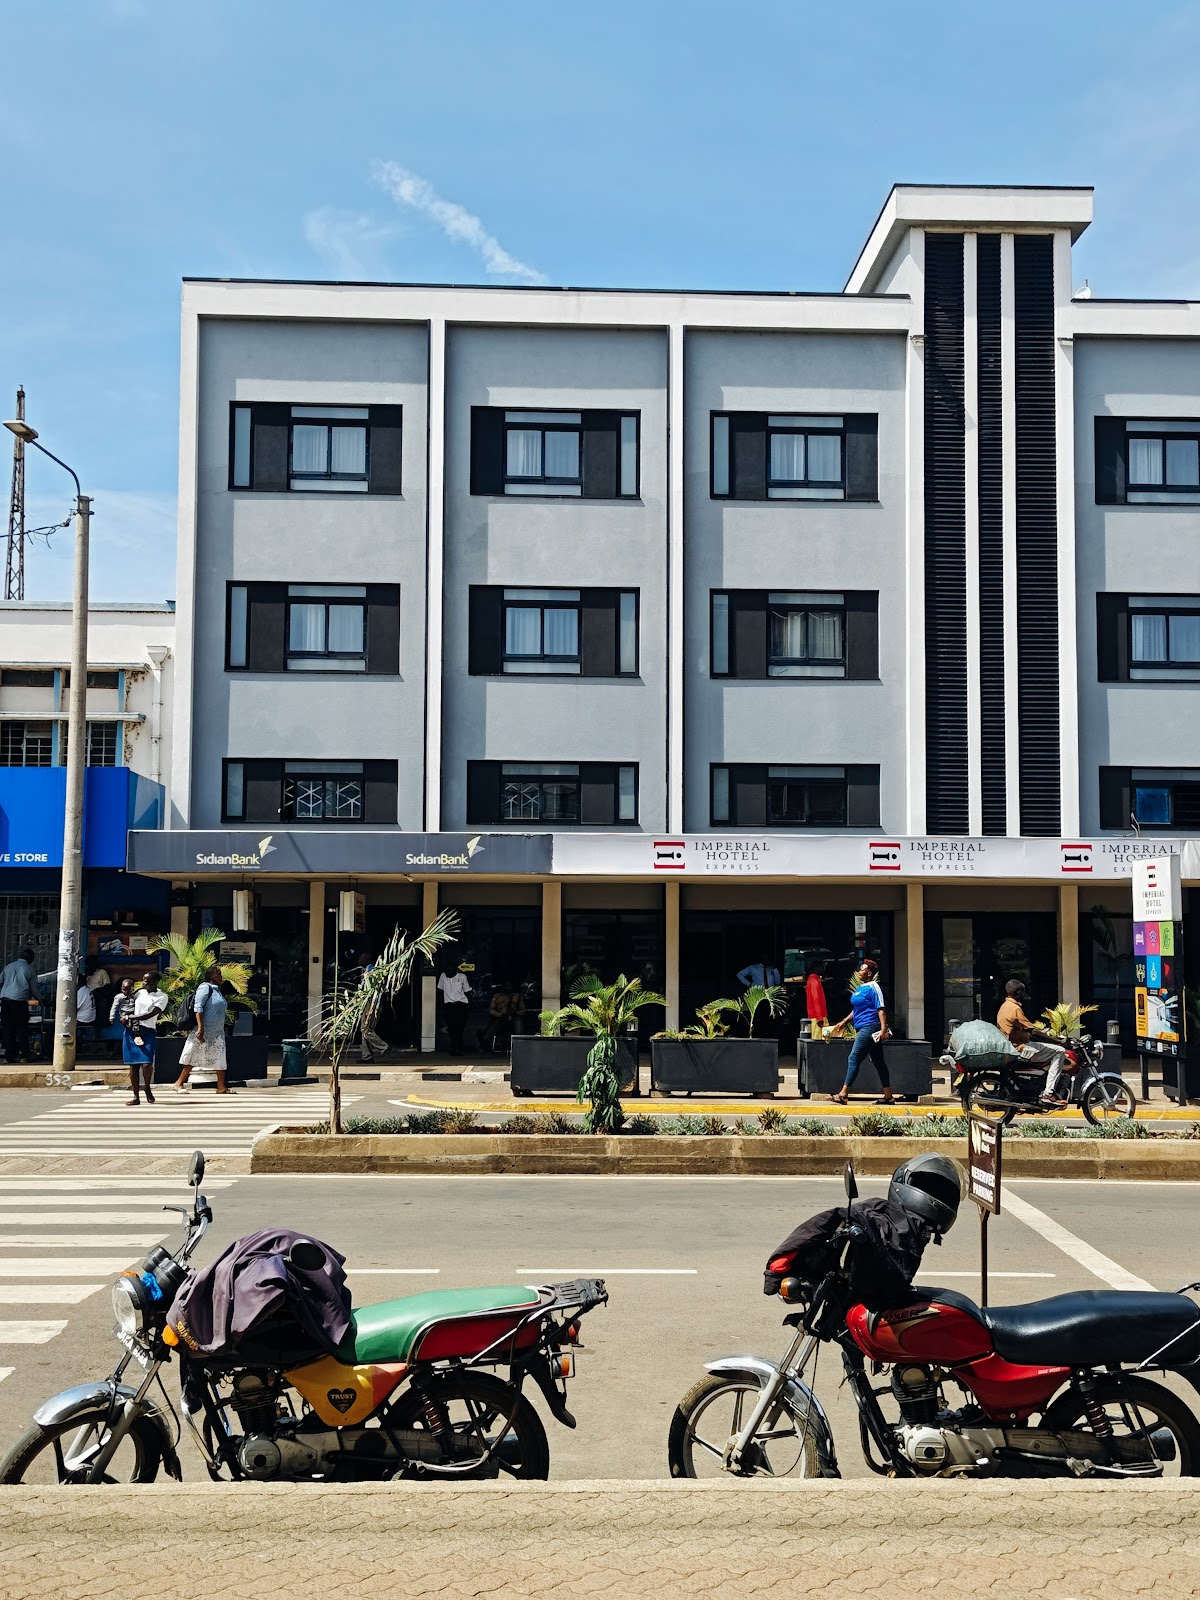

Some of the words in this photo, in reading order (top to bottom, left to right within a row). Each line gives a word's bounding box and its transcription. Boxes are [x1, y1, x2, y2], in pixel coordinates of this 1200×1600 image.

[695, 842, 770, 851] IMPERIAL
[910, 842, 986, 851] IMPERIAL
[1102, 844, 1177, 854] IMPERIAL
[14, 853, 48, 862] STORE
[706, 851, 759, 860] HOTEL
[922, 852, 975, 861] HOTEL
[1142, 890, 1165, 898] IMPERIAL
[1146, 899, 1162, 907] HOTEL
[973, 1182, 994, 1203] PARKING
